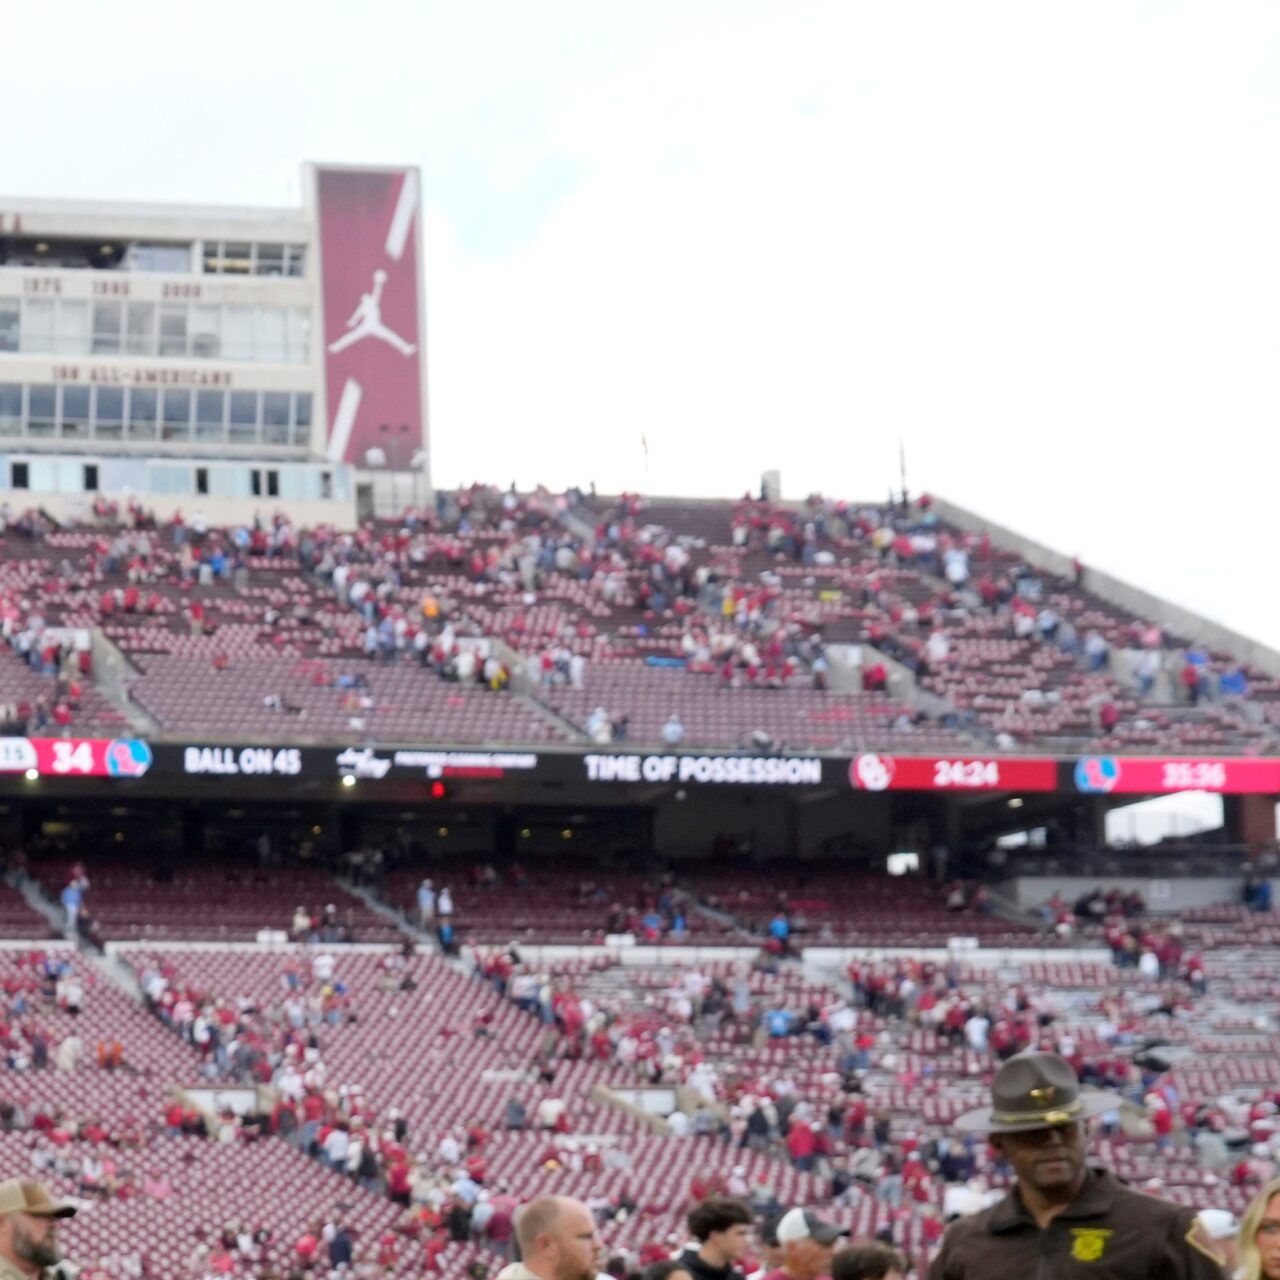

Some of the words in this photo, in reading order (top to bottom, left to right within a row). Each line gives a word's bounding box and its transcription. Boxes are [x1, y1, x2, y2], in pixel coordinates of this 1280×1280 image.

[89, 365, 233, 386] ALL-AMERICANS
[51, 741, 95, 774] 34
[184, 746, 239, 775] BALL
[239, 747, 273, 775] ON
[273, 748, 302, 775] 45
[583, 754, 642, 782] TIME
[642, 755, 678, 782] OF
[678, 756, 823, 784] POSSESSION
